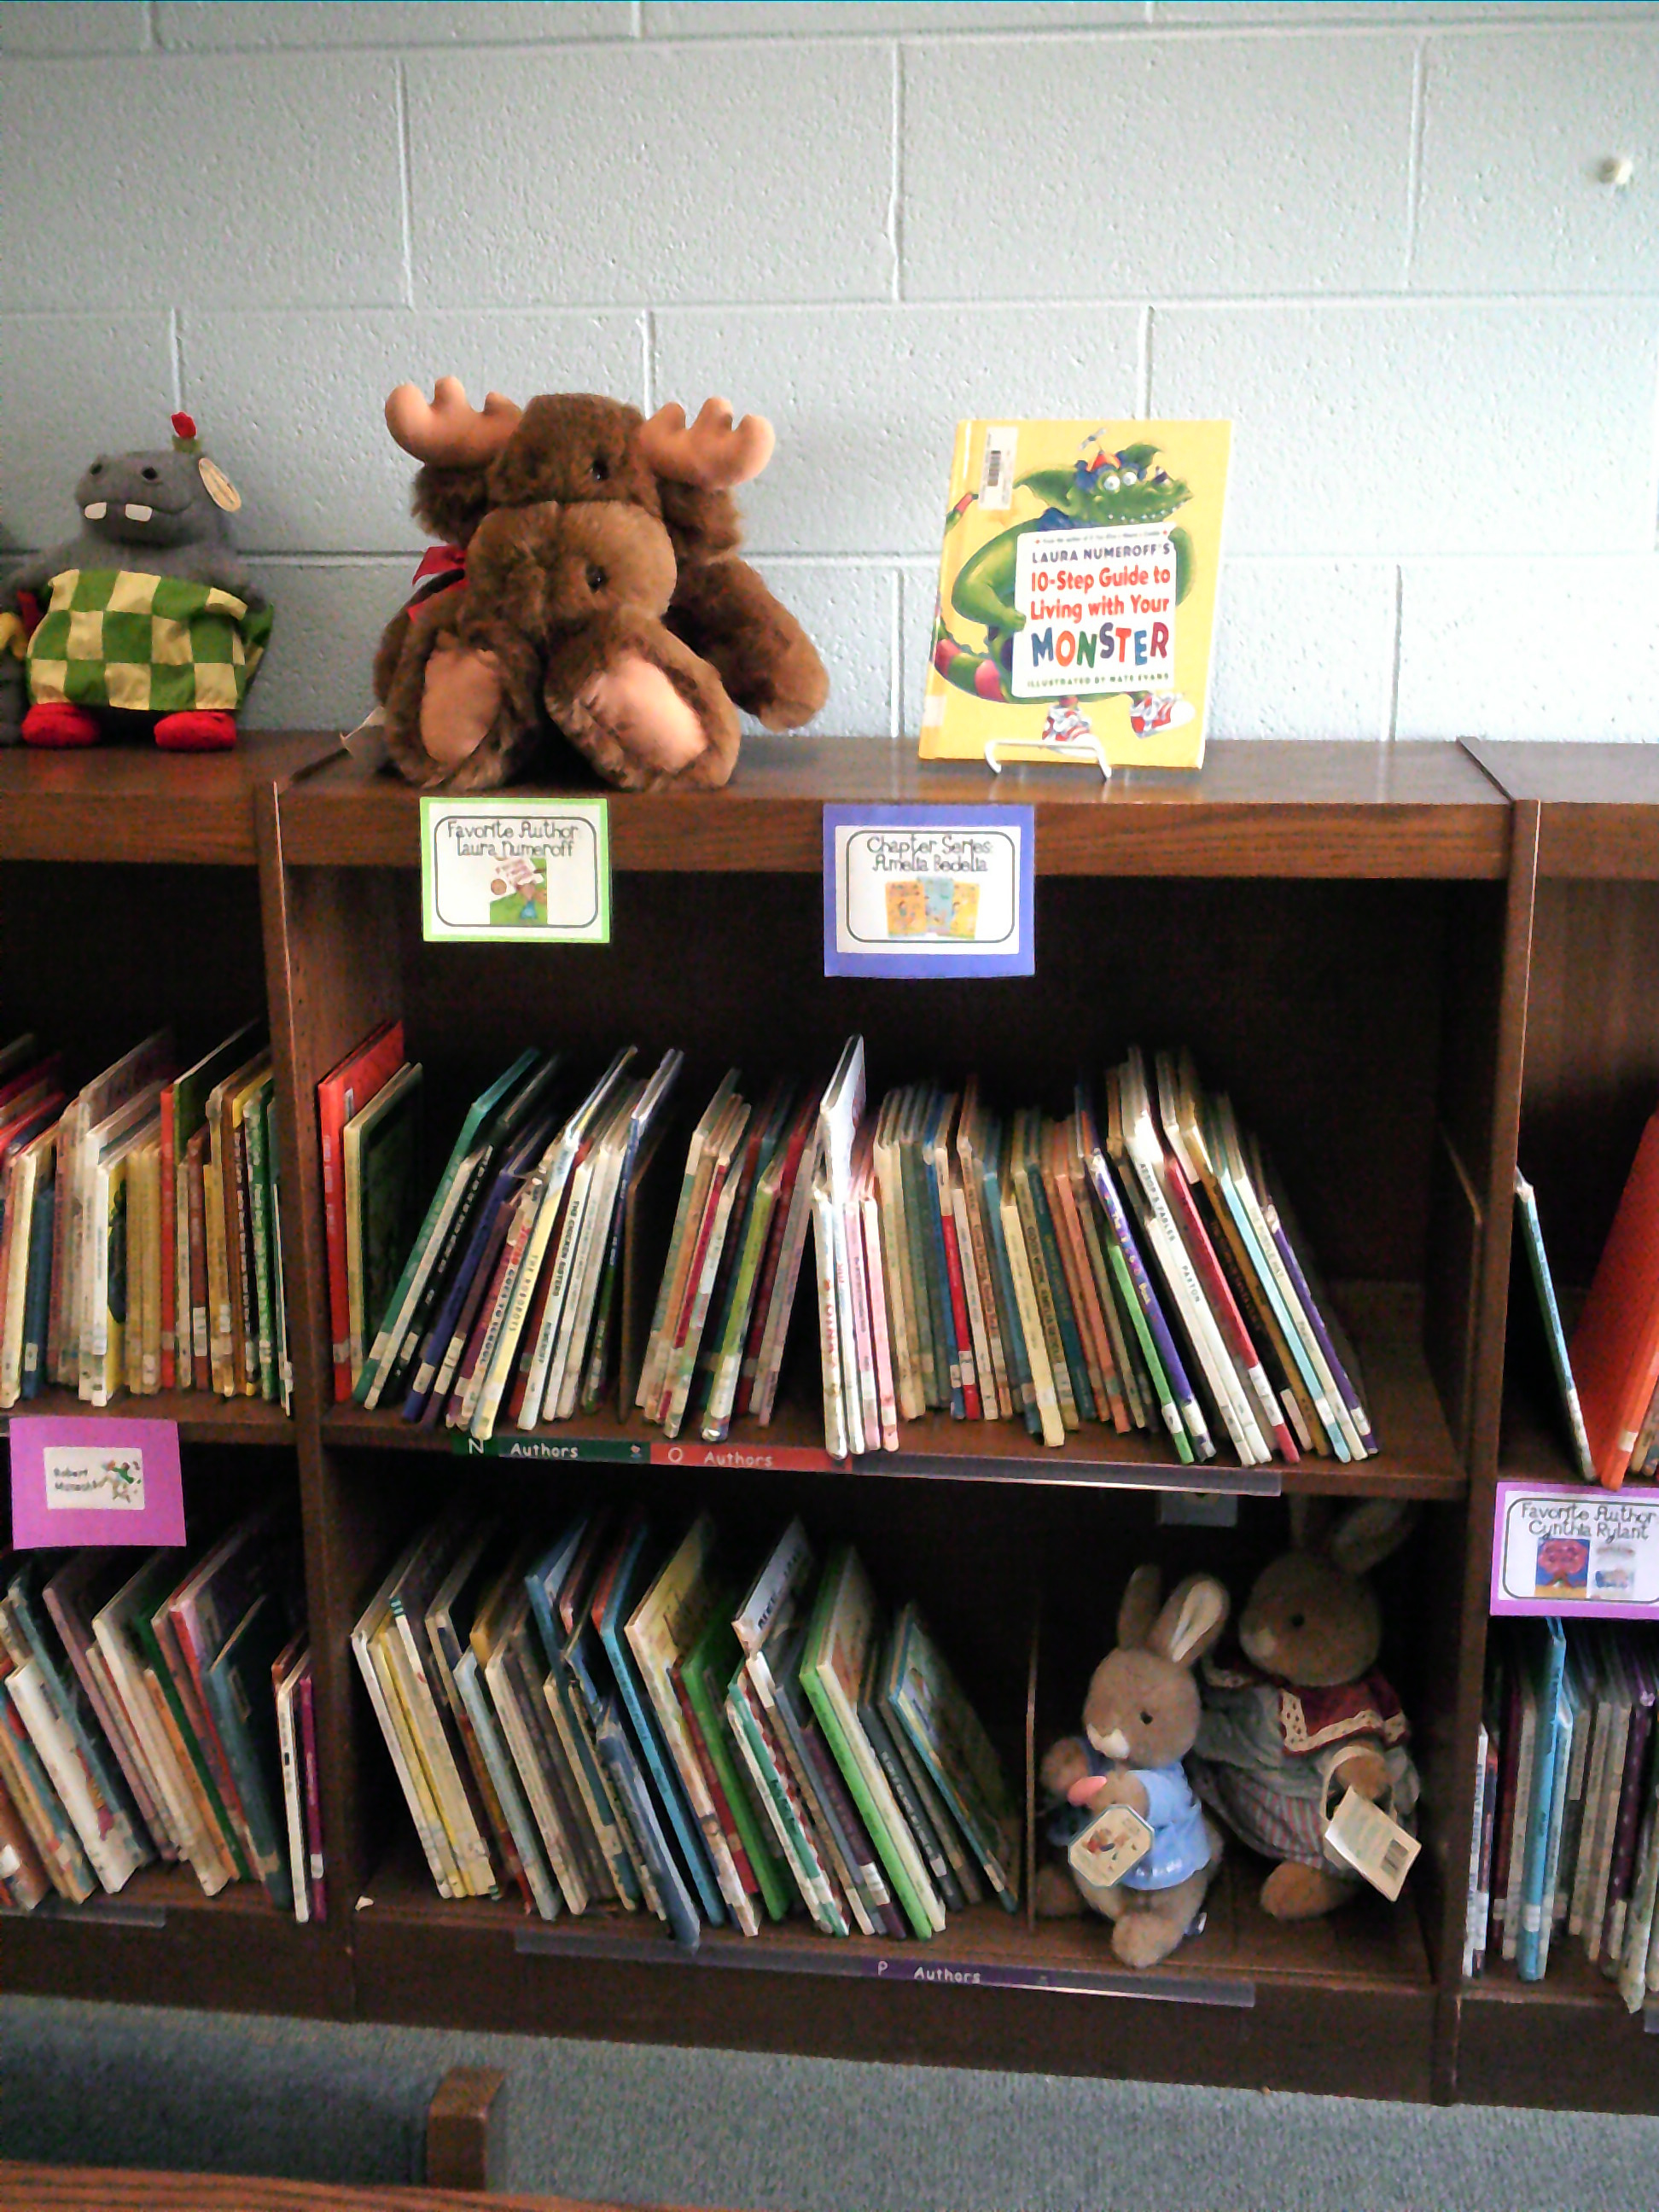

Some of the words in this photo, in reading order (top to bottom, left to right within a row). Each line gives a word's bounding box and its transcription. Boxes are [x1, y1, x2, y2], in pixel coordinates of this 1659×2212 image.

[1032, 549, 1079, 564] LAURA
[1031, 569, 1095, 594] 10-Step
[1099, 564, 1149, 588] Guide
[1154, 565, 1171, 584] to
[1030, 598, 1082, 625] Living
[1088, 595, 1125, 617] with
[1130, 594, 1170, 614] Your
[1031, 621, 1169, 669] MONSTER
[447, 819, 515, 839] Favorite
[457, 834, 497, 856] Laura
[866, 832, 938, 859] Chapter
[871, 854, 929, 872] Amelia
[934, 853, 989, 872] Bedelia
[469, 1437, 484, 1454] N
[511, 1441, 579, 1460] Authors
[667, 1447, 684, 1464] O
[704, 1451, 773, 1468] Authors
[1522, 1502, 1590, 1521] Favorite
[1593, 1505, 1657, 1523] Author
[1528, 1520, 1592, 1540] Cynthia
[1596, 1521, 1650, 1544] Rylant
[877, 1960, 888, 1976] P
[914, 1966, 981, 1985] Authors
